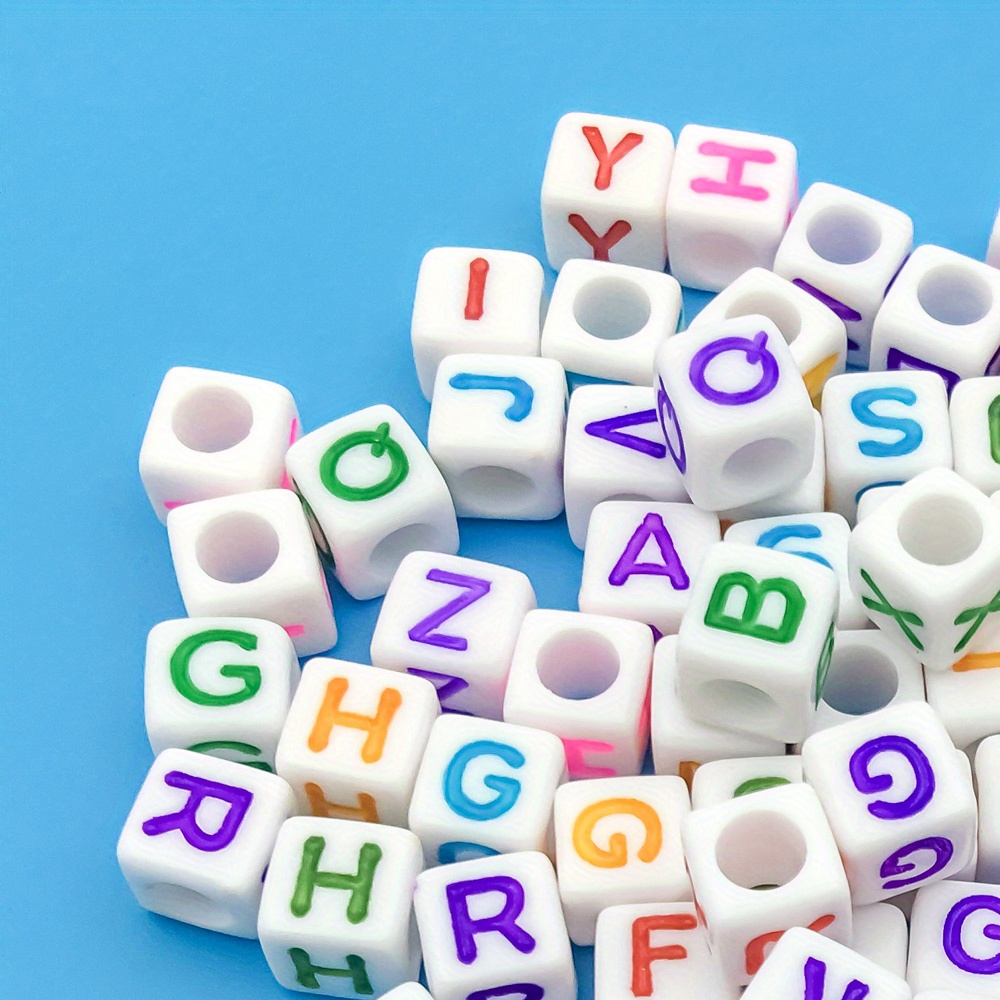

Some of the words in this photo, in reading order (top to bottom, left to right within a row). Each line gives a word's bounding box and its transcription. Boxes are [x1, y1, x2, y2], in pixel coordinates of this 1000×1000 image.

[582, 126, 643, 190] Y
[691, 142, 775, 201] H
[568, 214, 632, 261] Y
[464, 258, 489, 320] I
[689, 331, 779, 406] Q
[584, 409, 667, 459] V
[850, 387, 923, 458] S
[320, 423, 409, 501] Q
[608, 512, 690, 590] A
[408, 569, 491, 651] Z
[704, 572, 806, 643] B
[170, 630, 261, 706] G
[307, 677, 402, 764] H
[142, 771, 253, 852] R
[304, 782, 381, 829] H
[443, 740, 525, 822] G
[849, 735, 935, 820] G
[572, 798, 662, 869] G
[880, 837, 954, 889] G
[291, 837, 381, 923] H
[446, 876, 536, 965] R
[631, 914, 697, 997] F
[287, 948, 371, 992] H
